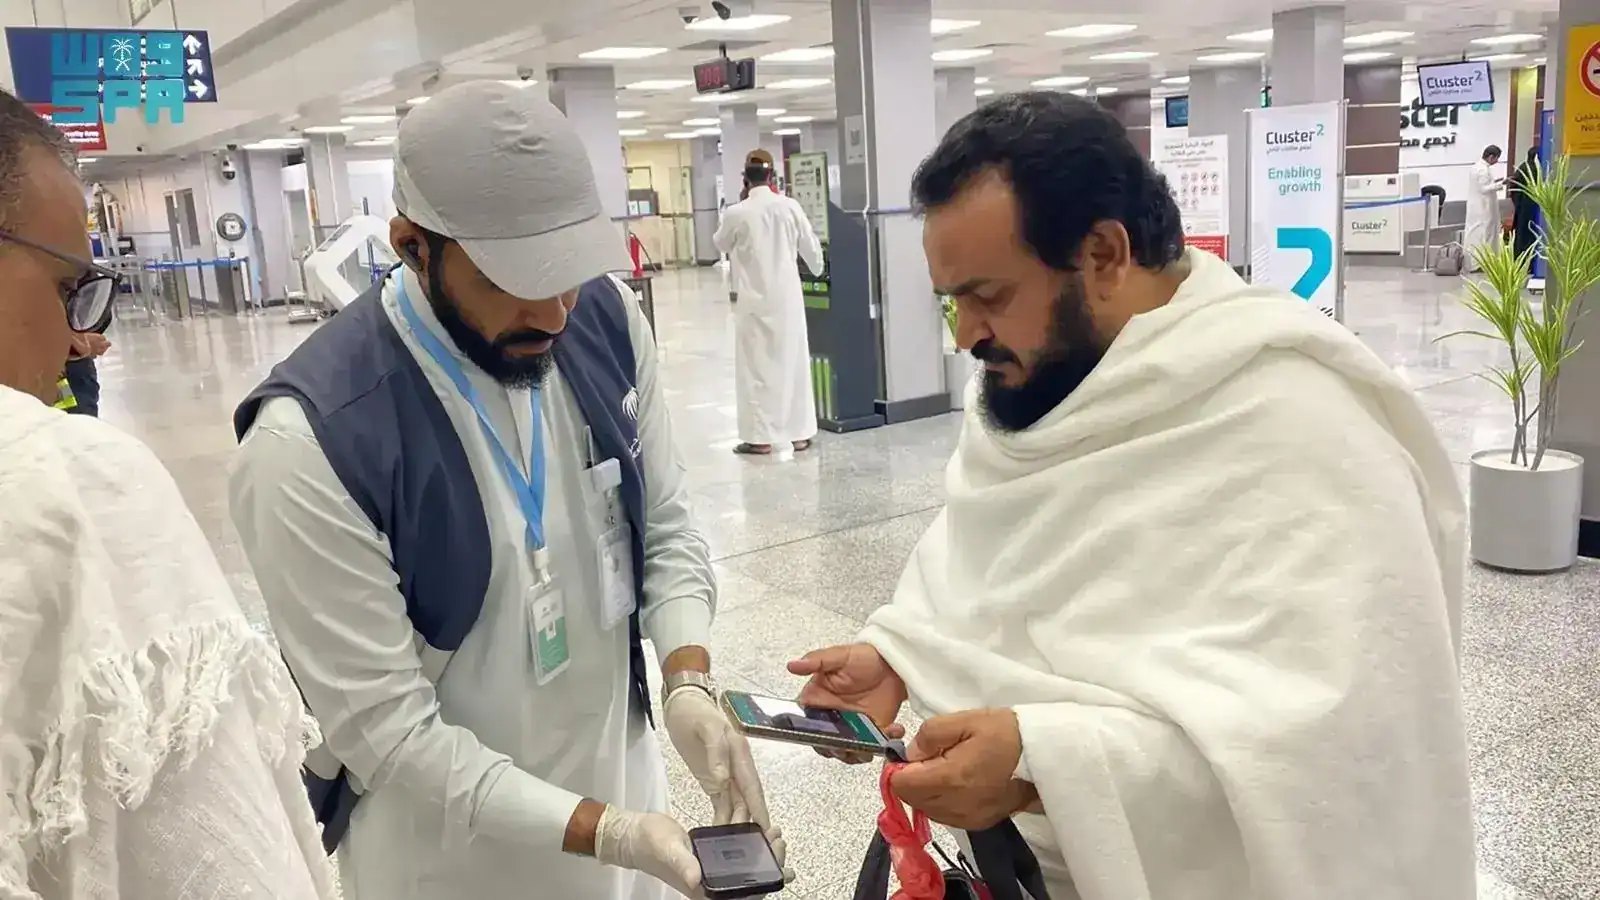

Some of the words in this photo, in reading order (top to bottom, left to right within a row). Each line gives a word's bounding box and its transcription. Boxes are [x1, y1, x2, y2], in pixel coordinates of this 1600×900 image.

[1423, 132, 1457, 149] تجمع
[1268, 166, 1321, 180] Enabling
[1279, 181, 1321, 195] growth
[1277, 228, 1332, 301] 2
